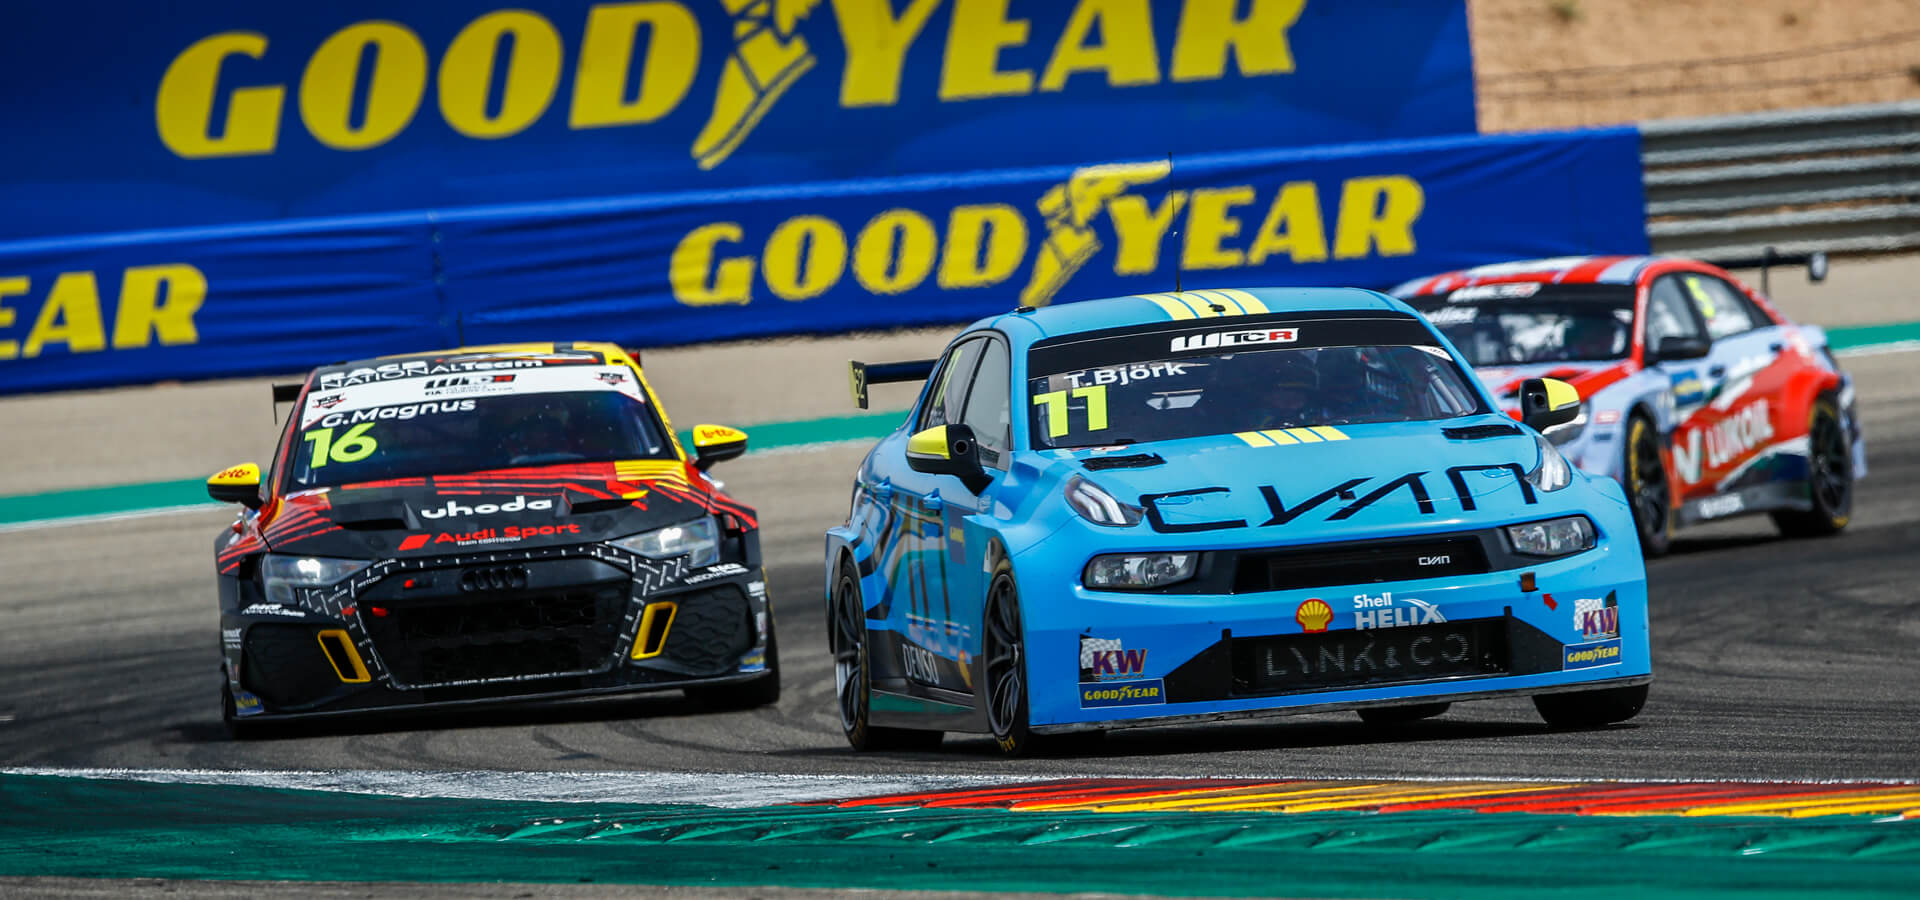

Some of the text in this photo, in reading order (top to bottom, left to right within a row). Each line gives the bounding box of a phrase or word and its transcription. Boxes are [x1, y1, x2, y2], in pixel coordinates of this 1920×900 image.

[1170, 328, 1299, 352] WTCR
[1063, 362, 1187, 389] T.Björk
[321, 399, 477, 428] G.Magnus
[1033, 385, 1108, 439] 11
[304, 422, 378, 469] 16
[421, 495, 553, 519] uhoda
[434, 523, 581, 544] Audi Sport
[1353, 592, 1392, 609] Shell
[1354, 600, 1448, 630] HELIX
[1583, 605, 1618, 636] KW
[902, 643, 940, 684] DENSO
[1093, 648, 1147, 675] KW
[1084, 686, 1159, 701] GOODYEAR
